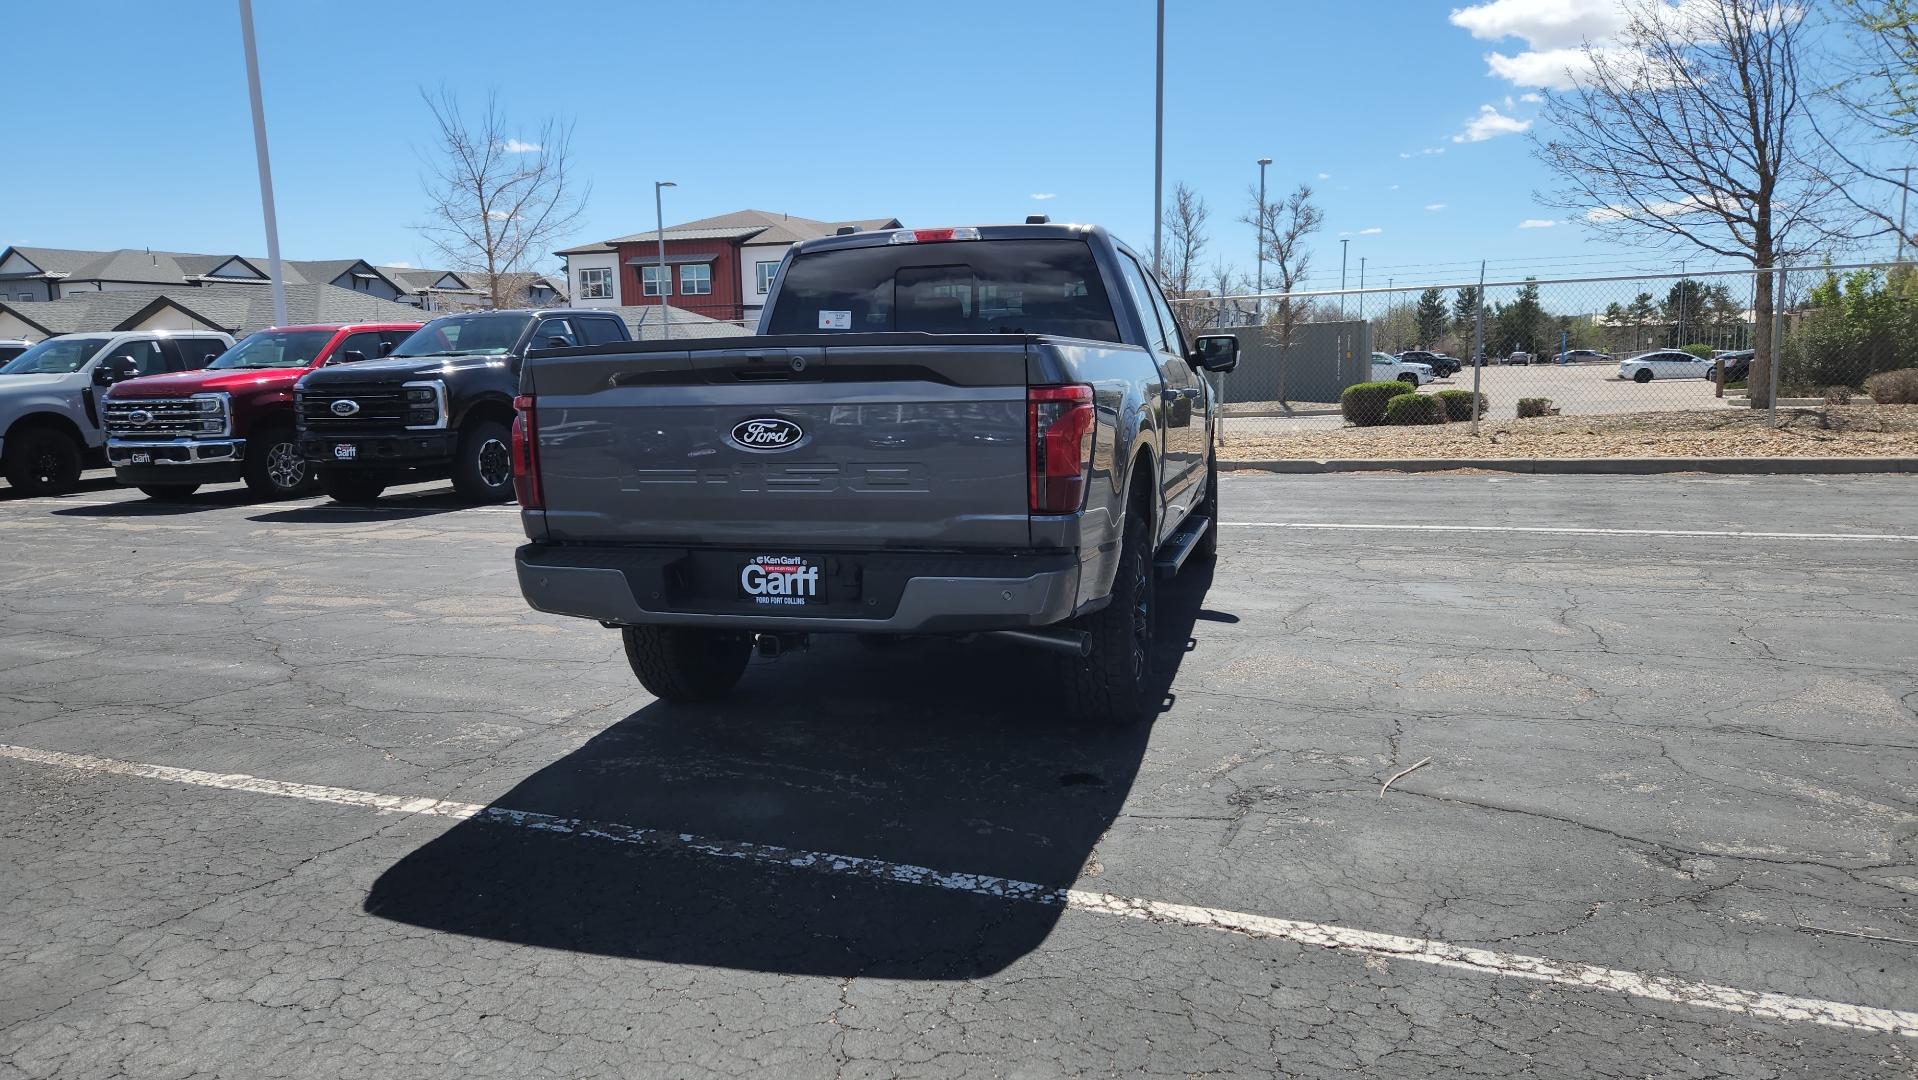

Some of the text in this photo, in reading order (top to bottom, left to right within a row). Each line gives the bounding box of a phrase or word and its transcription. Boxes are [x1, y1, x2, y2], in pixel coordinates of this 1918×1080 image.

[743, 422, 788, 444] Ford
[334, 446, 356, 457] Garff
[620, 461, 931, 493] F-150
[764, 555, 801, 565] Ken Garff
[741, 564, 818, 596] Garff
[756, 596, 805, 605] FORD FORT COLLINS
